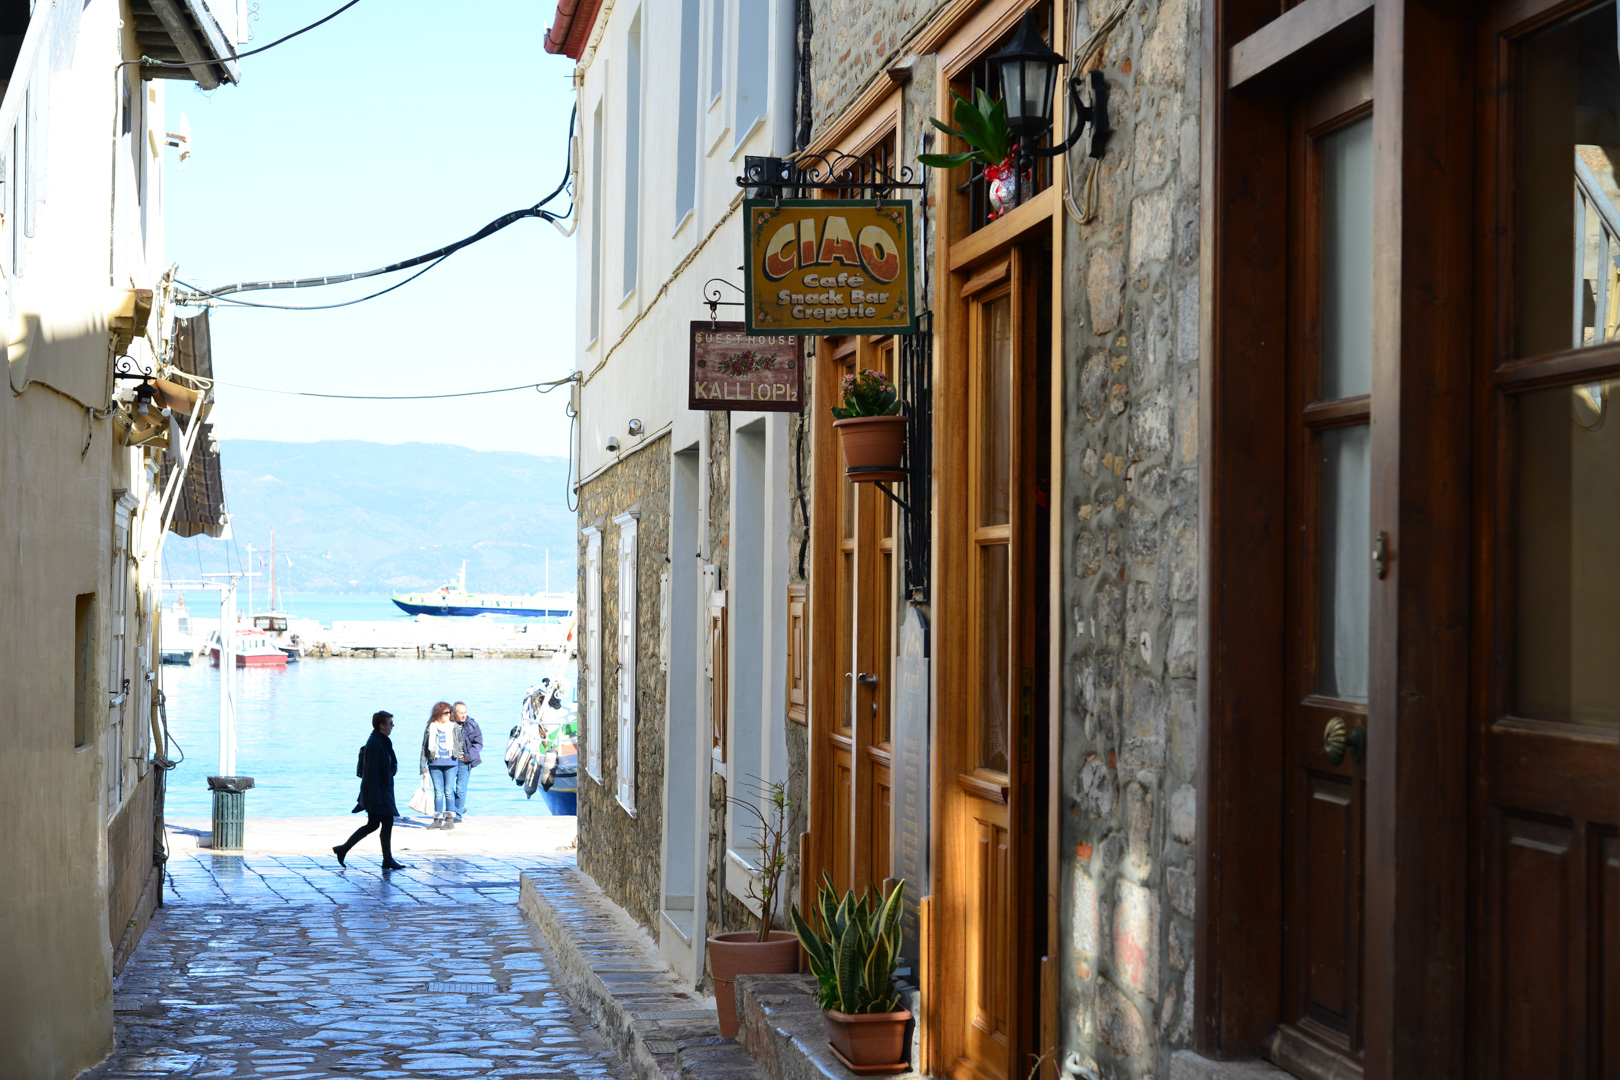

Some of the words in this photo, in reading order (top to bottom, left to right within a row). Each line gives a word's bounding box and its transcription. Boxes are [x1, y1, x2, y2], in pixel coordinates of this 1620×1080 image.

[764, 215, 900, 284] CIAO
[803, 273, 864, 288] Café
[778, 290, 843, 305] Snack
[850, 290, 889, 304] Bar
[792, 304, 876, 322] Creperie
[695, 333, 742, 344] GUEST
[749, 335, 795, 346] HOUSE
